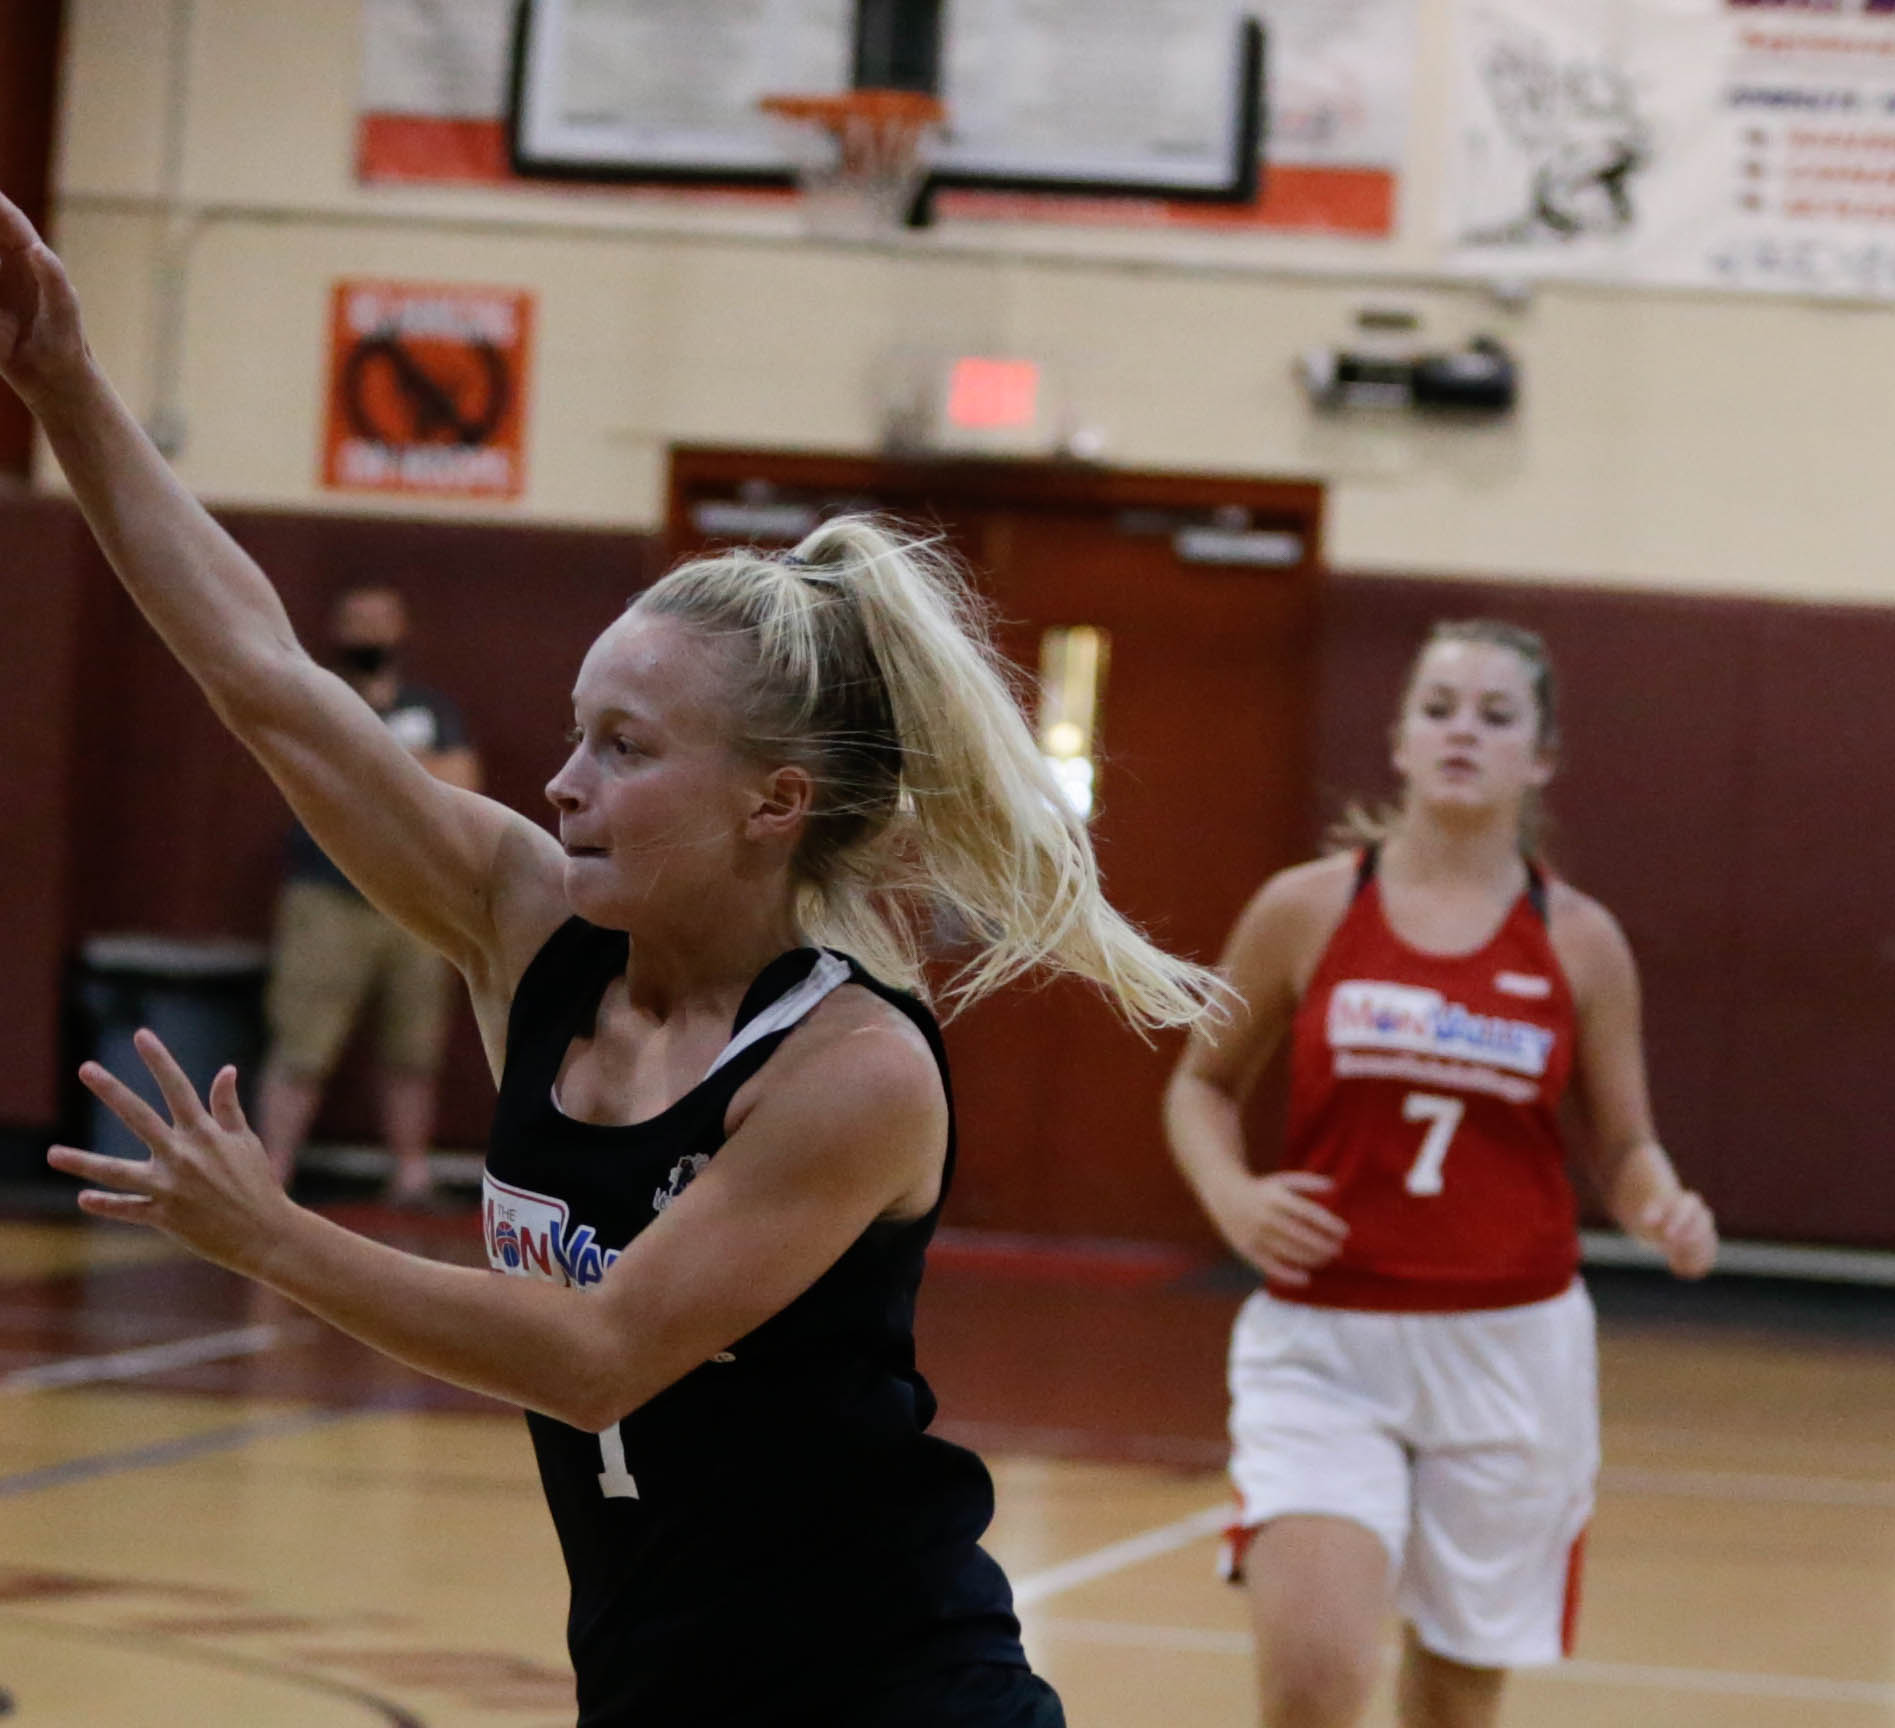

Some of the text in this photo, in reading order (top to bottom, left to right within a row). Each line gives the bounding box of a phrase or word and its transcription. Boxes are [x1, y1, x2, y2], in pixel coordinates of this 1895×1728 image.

[1403, 1095, 1465, 1194] 7
[497, 1203, 517, 1222] THE
[597, 1420, 640, 1500] 1
